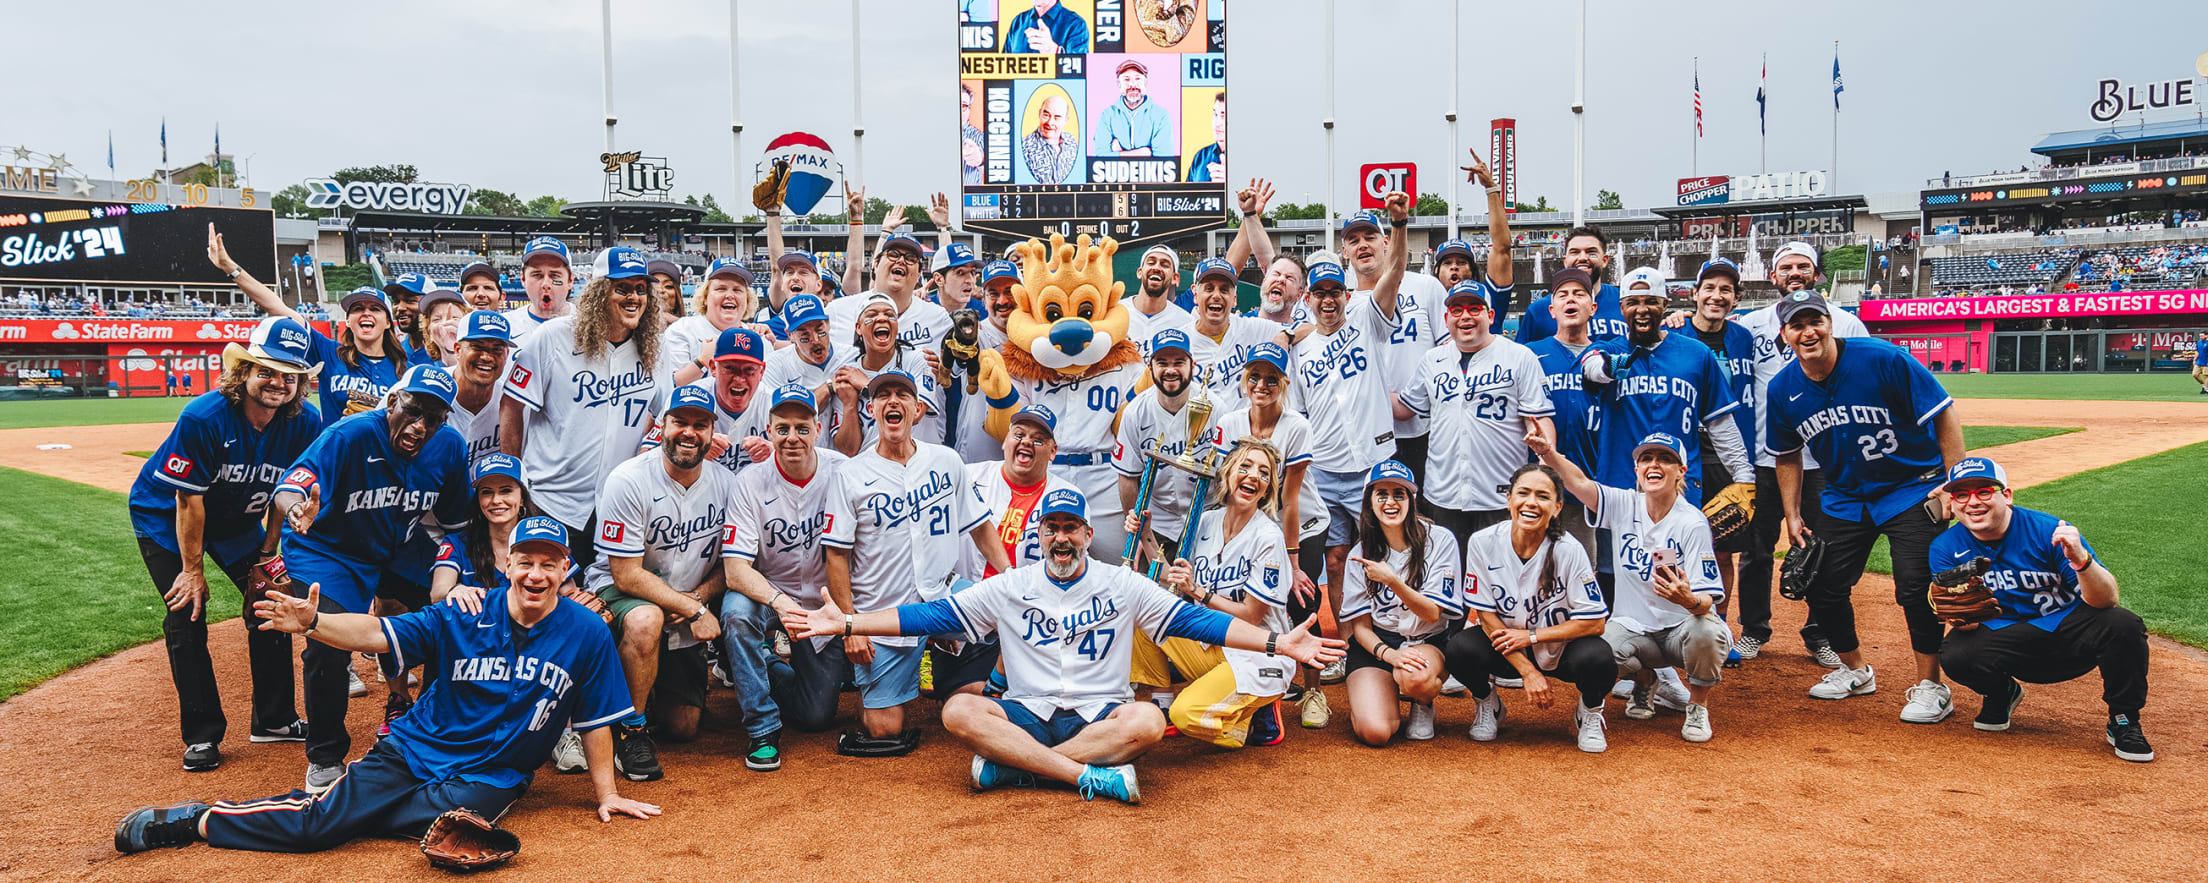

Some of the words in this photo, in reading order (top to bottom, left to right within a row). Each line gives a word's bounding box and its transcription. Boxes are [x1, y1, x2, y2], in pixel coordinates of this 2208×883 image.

[962, 57, 1049, 74] NESTREET
[1190, 58, 1224, 79] RIG
[2090, 79, 2192, 121] BLUE
[988, 88, 1010, 182] KOECHNER
[601, 151, 641, 172] Miller
[1092, 161, 1176, 182] SUDEIKIS
[1507, 134, 1515, 202] BOULEVARD
[0, 166, 59, 193] ME
[126, 180, 157, 202] 20
[616, 162, 674, 198] Lite
[1366, 168, 1408, 199] QT
[1680, 178, 1711, 193] PRICE
[1735, 171, 1826, 200] PATIO
[183, 184, 208, 204] 10
[241, 188, 256, 208] 5
[348, 185, 467, 214] evergy
[972, 196, 991, 206] BLUE
[1003, 195, 1008, 205] 3
[1015, 195, 1021, 205] 2
[1157, 198, 1172, 212] BIG
[1173, 198, 1201, 211] Slick
[1679, 185, 1728, 205] CHOPPER
[969, 209, 994, 219] WHITE
[1003, 208, 1009, 218] 4
[1016, 208, 1021, 218] 2
[1043, 226, 1058, 234] BALL
[1061, 222, 1070, 237] 0
[1076, 225, 1098, 234] STRIKE
[1100, 221, 1109, 237] 0
[1116, 225, 1128, 233] OUT
[1131, 221, 1139, 236] 2
[1, 231, 75, 267] Slick
[1880, 301, 1970, 317] AMERICA'S
[1975, 298, 2053, 315] LARGEST
[2057, 298, 2070, 312] &
[2074, 295, 2154, 311] FASTEST
[2159, 294, 2185, 309] 5G
[735, 333, 750, 350] KC
[1301, 326, 1358, 388] Royals
[1339, 347, 1367, 380] 26
[423, 368, 436, 379] BIG
[513, 368, 529, 385] QT
[573, 362, 655, 409] Royals
[1433, 364, 1513, 400] Royals
[1088, 385, 1119, 414] 00
[1672, 377, 1697, 408] CITY
[624, 398, 648, 427] 17
[1476, 394, 1508, 421] 23
[1682, 407, 1692, 434] 6
[1797, 406, 1850, 441] KANSAS
[1851, 406, 1892, 426] CITY
[1858, 429, 1899, 461] 23
[168, 457, 188, 474] QT
[290, 470, 312, 484] QT
[868, 471, 953, 527] Royals
[526, 519, 540, 529] BIG
[540, 519, 560, 531] Slick
[604, 523, 622, 539] QT
[647, 503, 726, 552] Royals
[930, 504, 950, 536] 21
[701, 536, 718, 562] 4
[1265, 569, 1279, 586] KC
[2020, 570, 2062, 590] CITY
[1022, 596, 1118, 645] Royals
[1078, 628, 1115, 661] 47
[451, 656, 539, 682] KANSAS
[540, 662, 574, 699] CITY
[528, 698, 557, 732] 16
